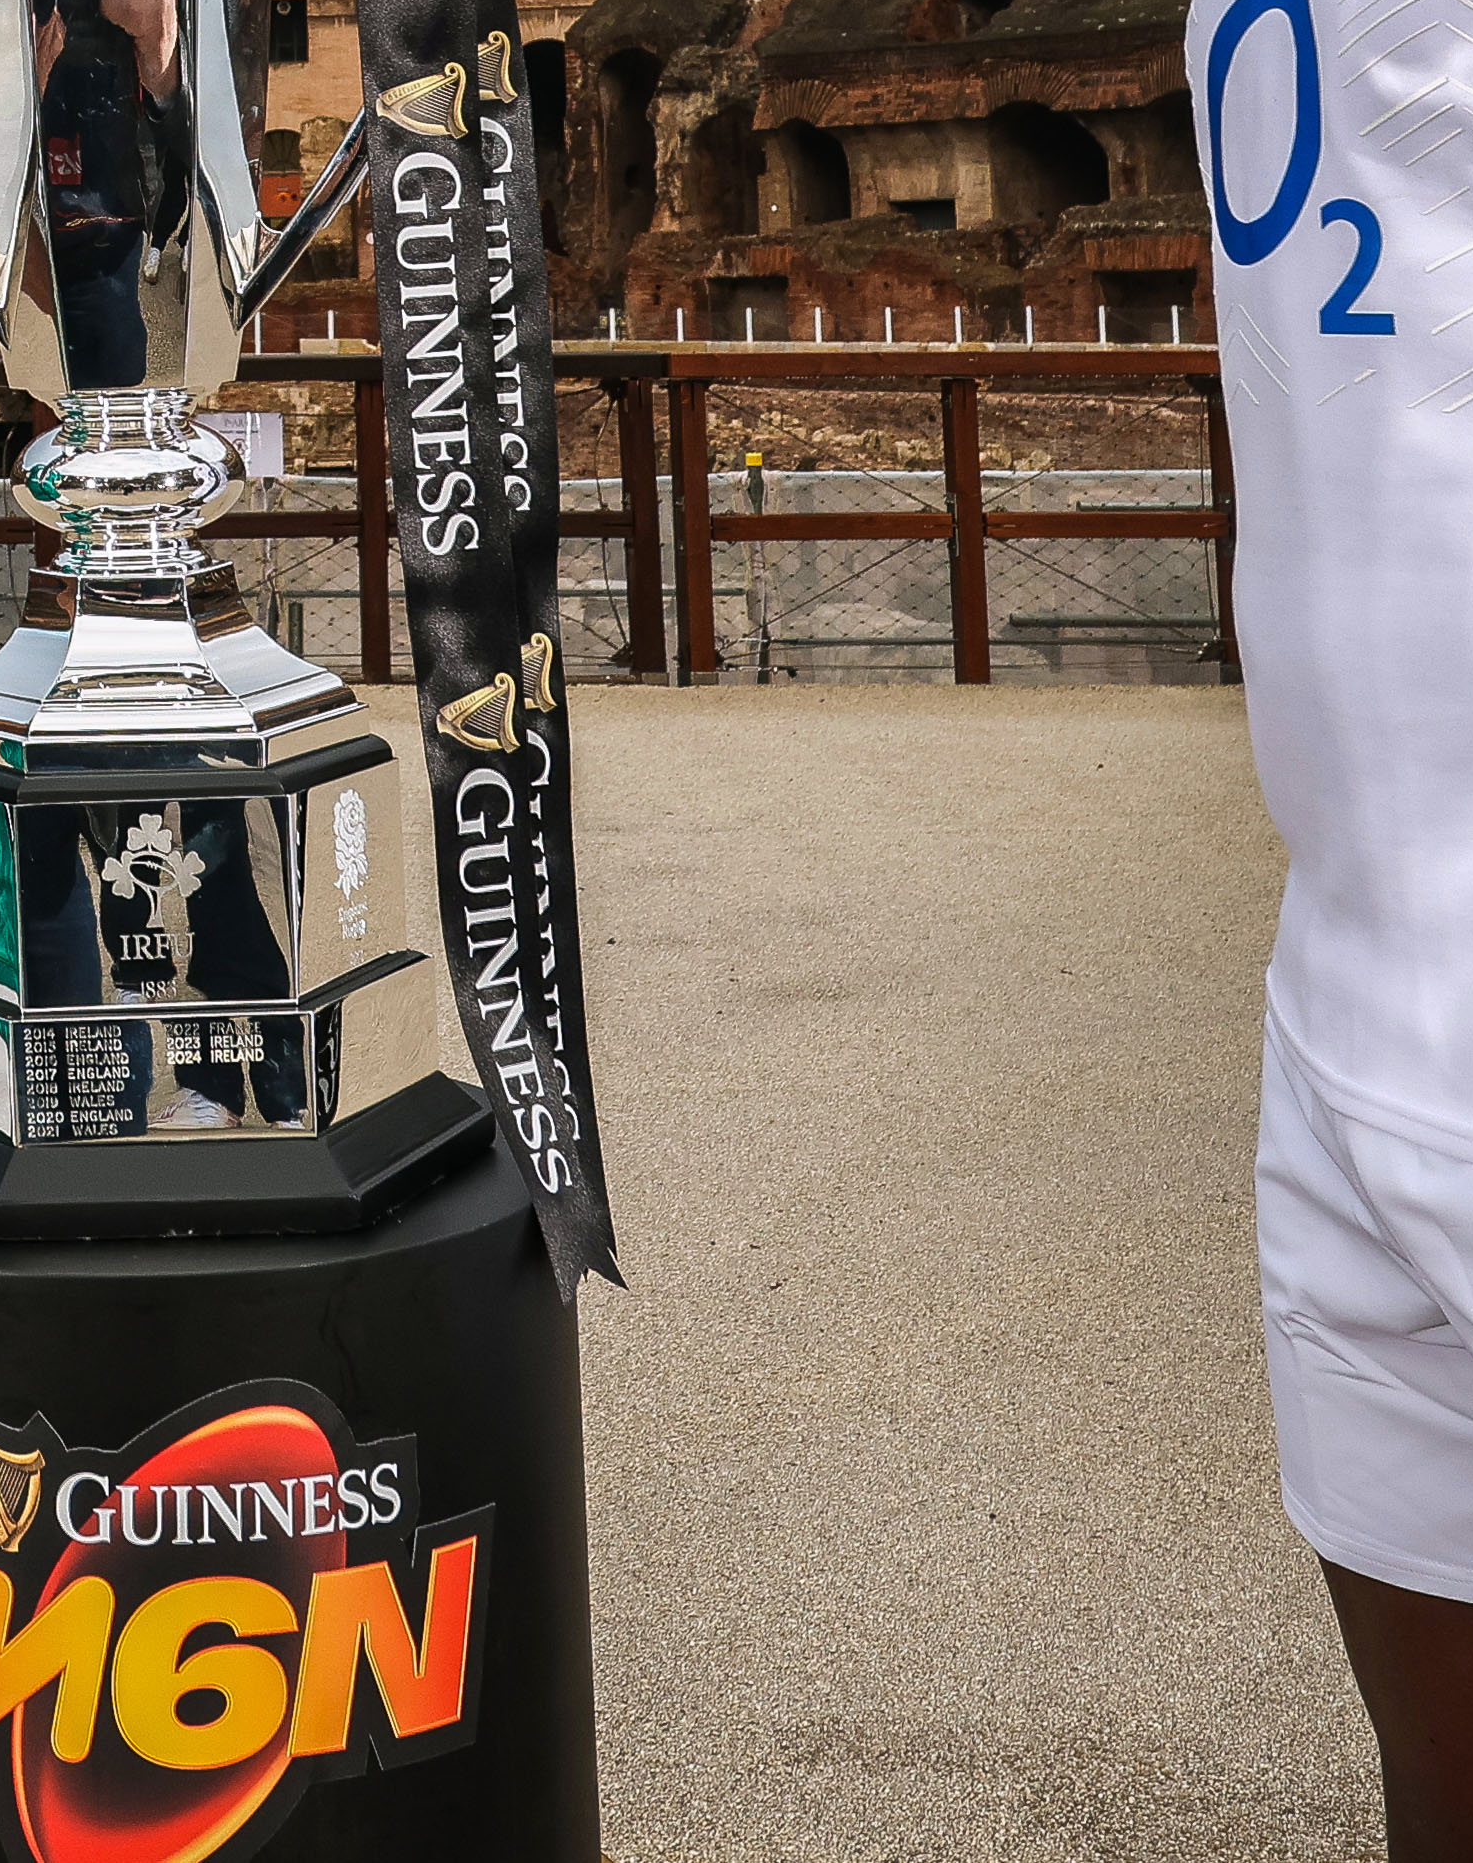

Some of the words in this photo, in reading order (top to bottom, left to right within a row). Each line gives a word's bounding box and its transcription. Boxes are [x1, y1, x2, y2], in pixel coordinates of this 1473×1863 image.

[392, 151, 480, 556] GUINNESS
[119, 931, 196, 960] IRFU
[456, 767, 573, 1195] GUINNESS
[23, 1028, 55, 1040] 2014
[65, 1025, 122, 1039] IRELAND
[165, 1023, 200, 1036] 2022
[209, 1021, 262, 1035] FRANCE
[24, 1040, 56, 1053] 2015
[65, 1039, 123, 1052] IRELAND
[166, 1037, 201, 1050] 2023
[210, 1035, 264, 1048] IRELAND
[66, 1052, 130, 1066] ENGLAND
[167, 1050, 202, 1064] 2024
[210, 1049, 265, 1062] IRELAND
[26, 1068, 57, 1081] 2017
[67, 1066, 130, 1080] ENGLAND
[68, 1080, 125, 1094] IRELAND
[69, 1094, 115, 1107] WALES
[27, 1111, 64, 1124] 2020
[70, 1109, 133, 1123] ENGLAND
[28, 1126, 60, 1138] 2021
[72, 1124, 118, 1137] WALES
[55, 1463, 403, 1547] GUINNESS
